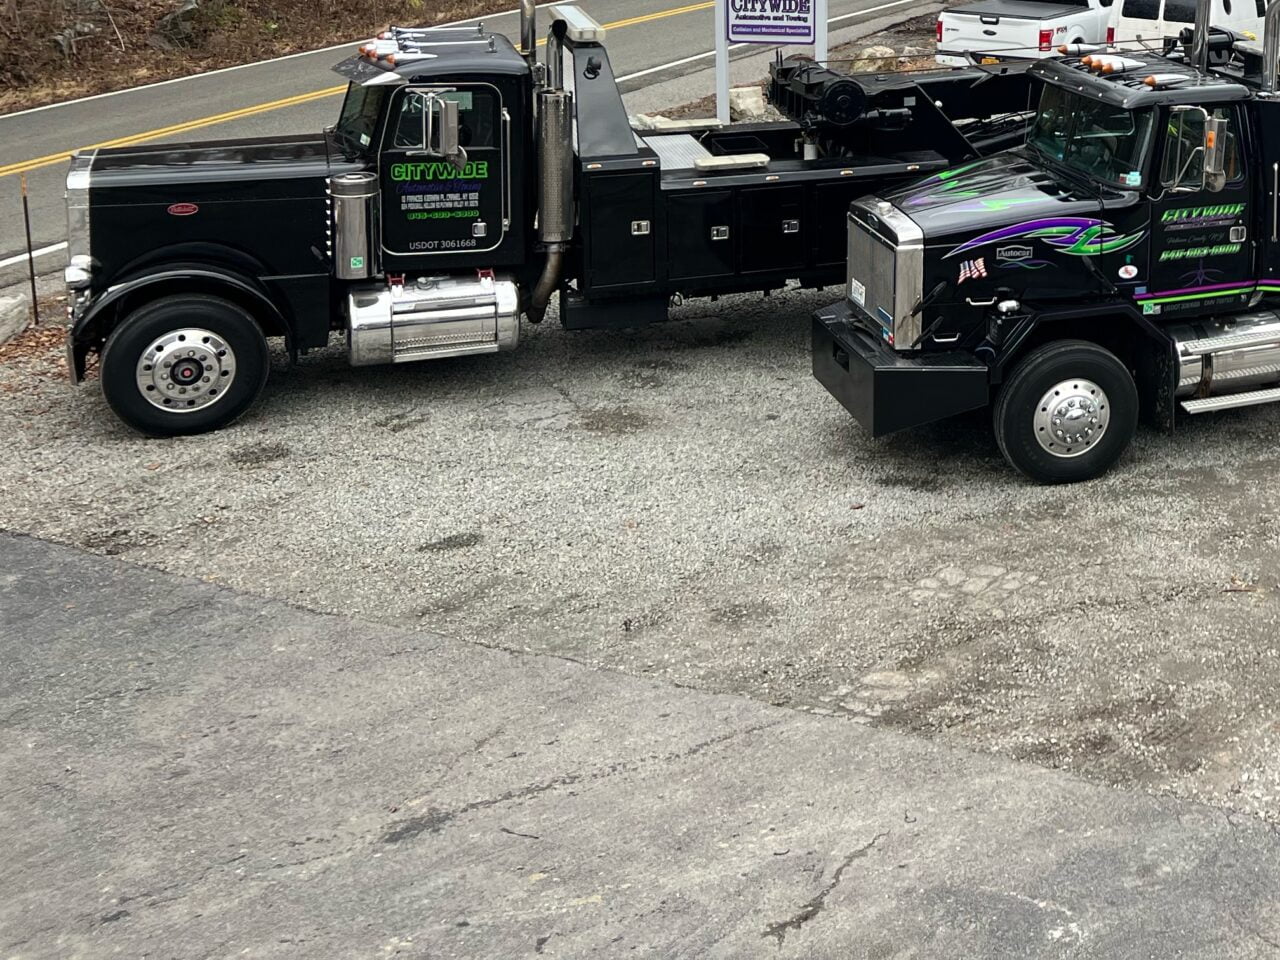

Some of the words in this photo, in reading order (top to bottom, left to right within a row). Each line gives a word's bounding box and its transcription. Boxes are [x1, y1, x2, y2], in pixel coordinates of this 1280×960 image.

[735, 13, 771, 21] Automotive
[772, 14, 785, 22] and
[785, 15, 808, 23] Towing
[409, 240, 440, 250] USDOT
[440, 239, 477, 249] 3061668
[999, 249, 1031, 257] Autocar
